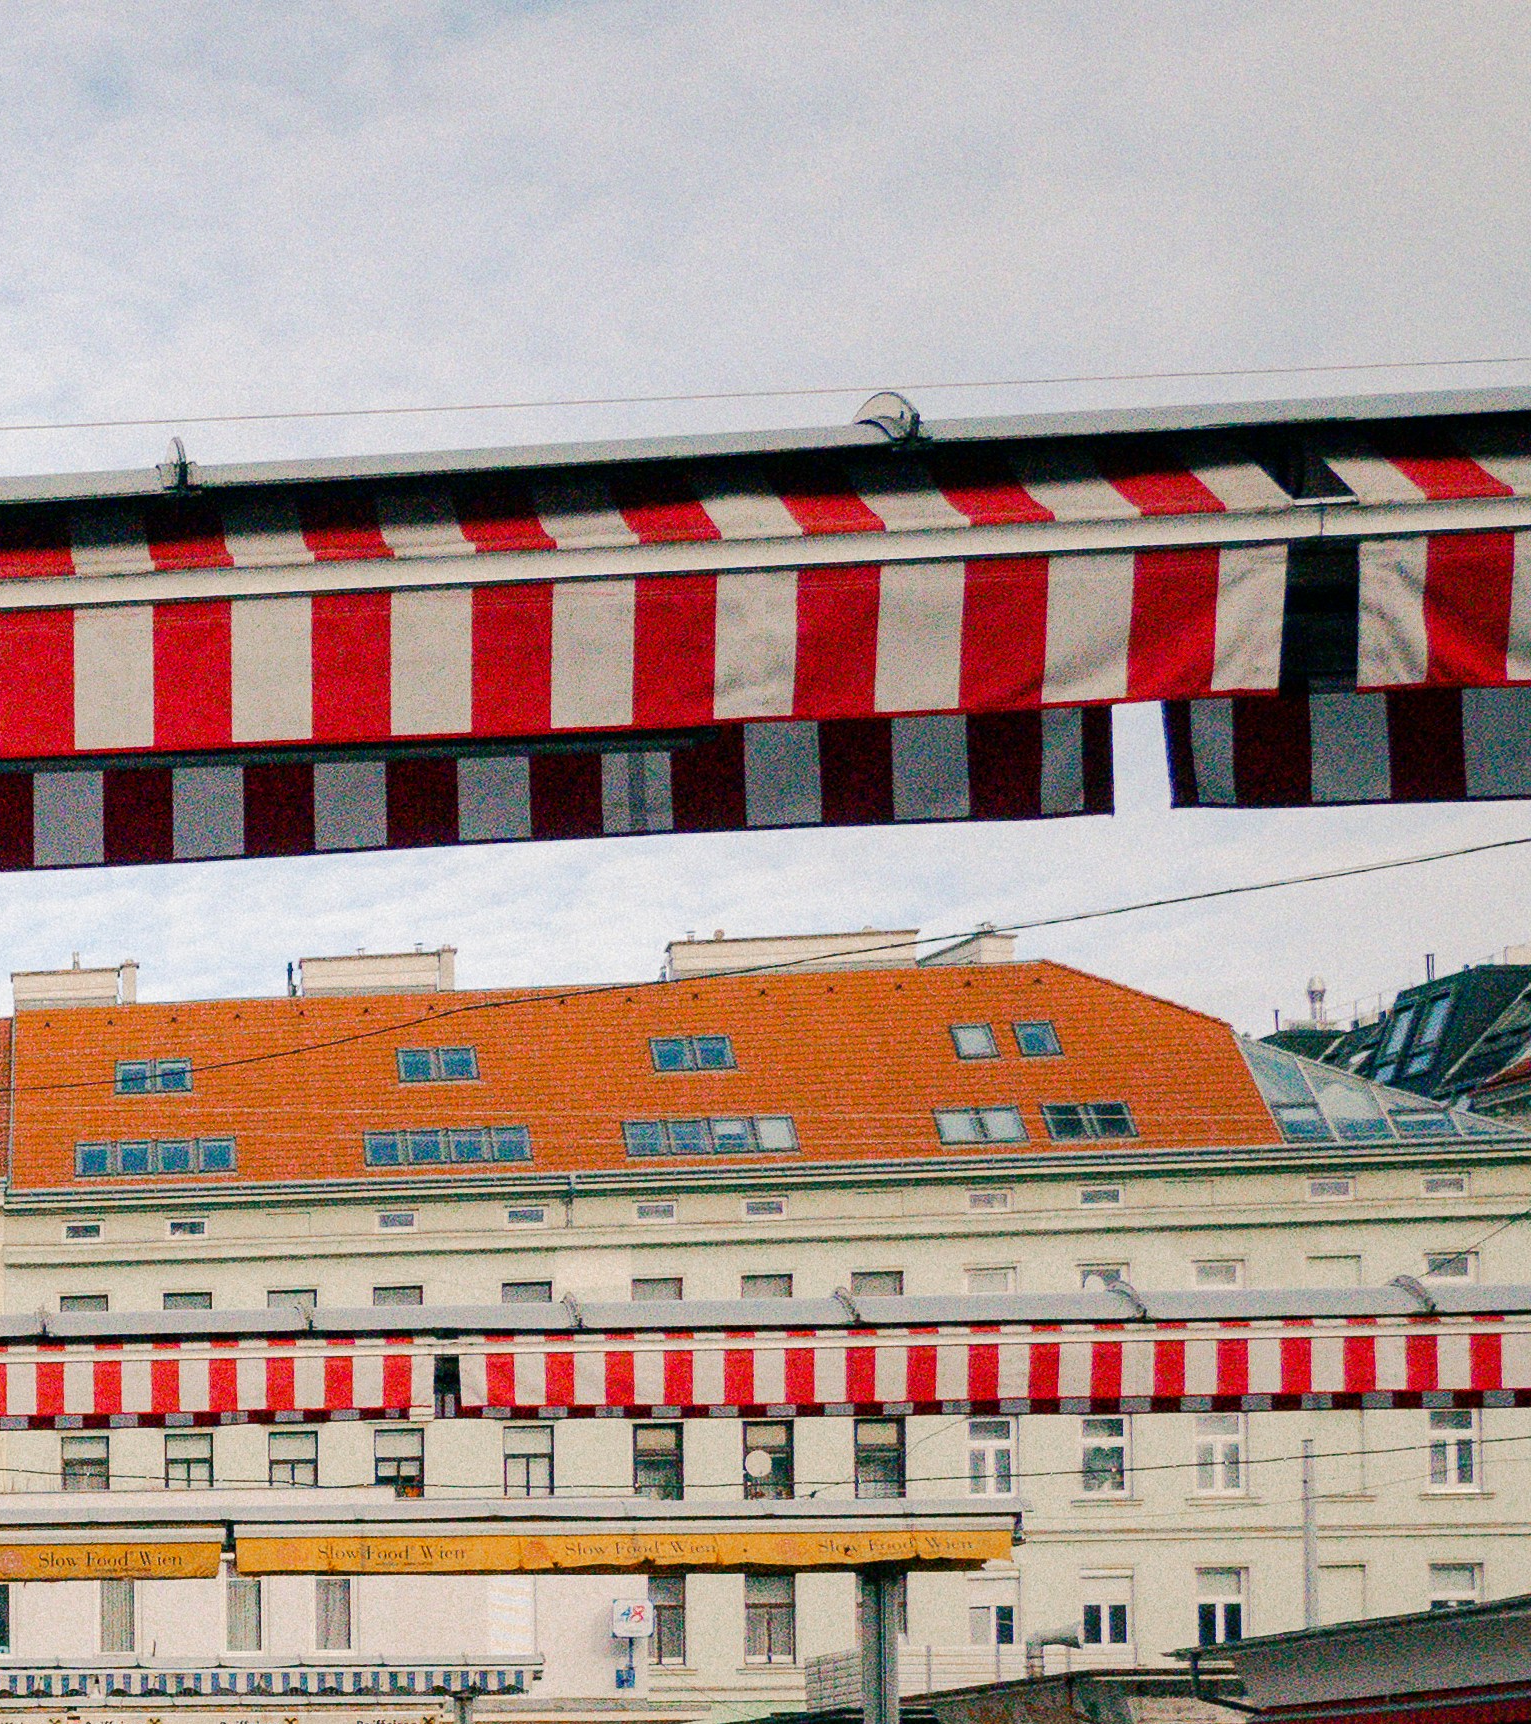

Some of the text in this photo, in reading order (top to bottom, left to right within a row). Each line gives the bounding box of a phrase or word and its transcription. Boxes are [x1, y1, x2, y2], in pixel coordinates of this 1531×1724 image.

[38, 1551, 77, 1567] Slow
[139, 1551, 182, 1566] Wien
[318, 1545, 358, 1560] Slow
[420, 1545, 465, 1560] Wien
[620, 1604, 645, 1623] 48
